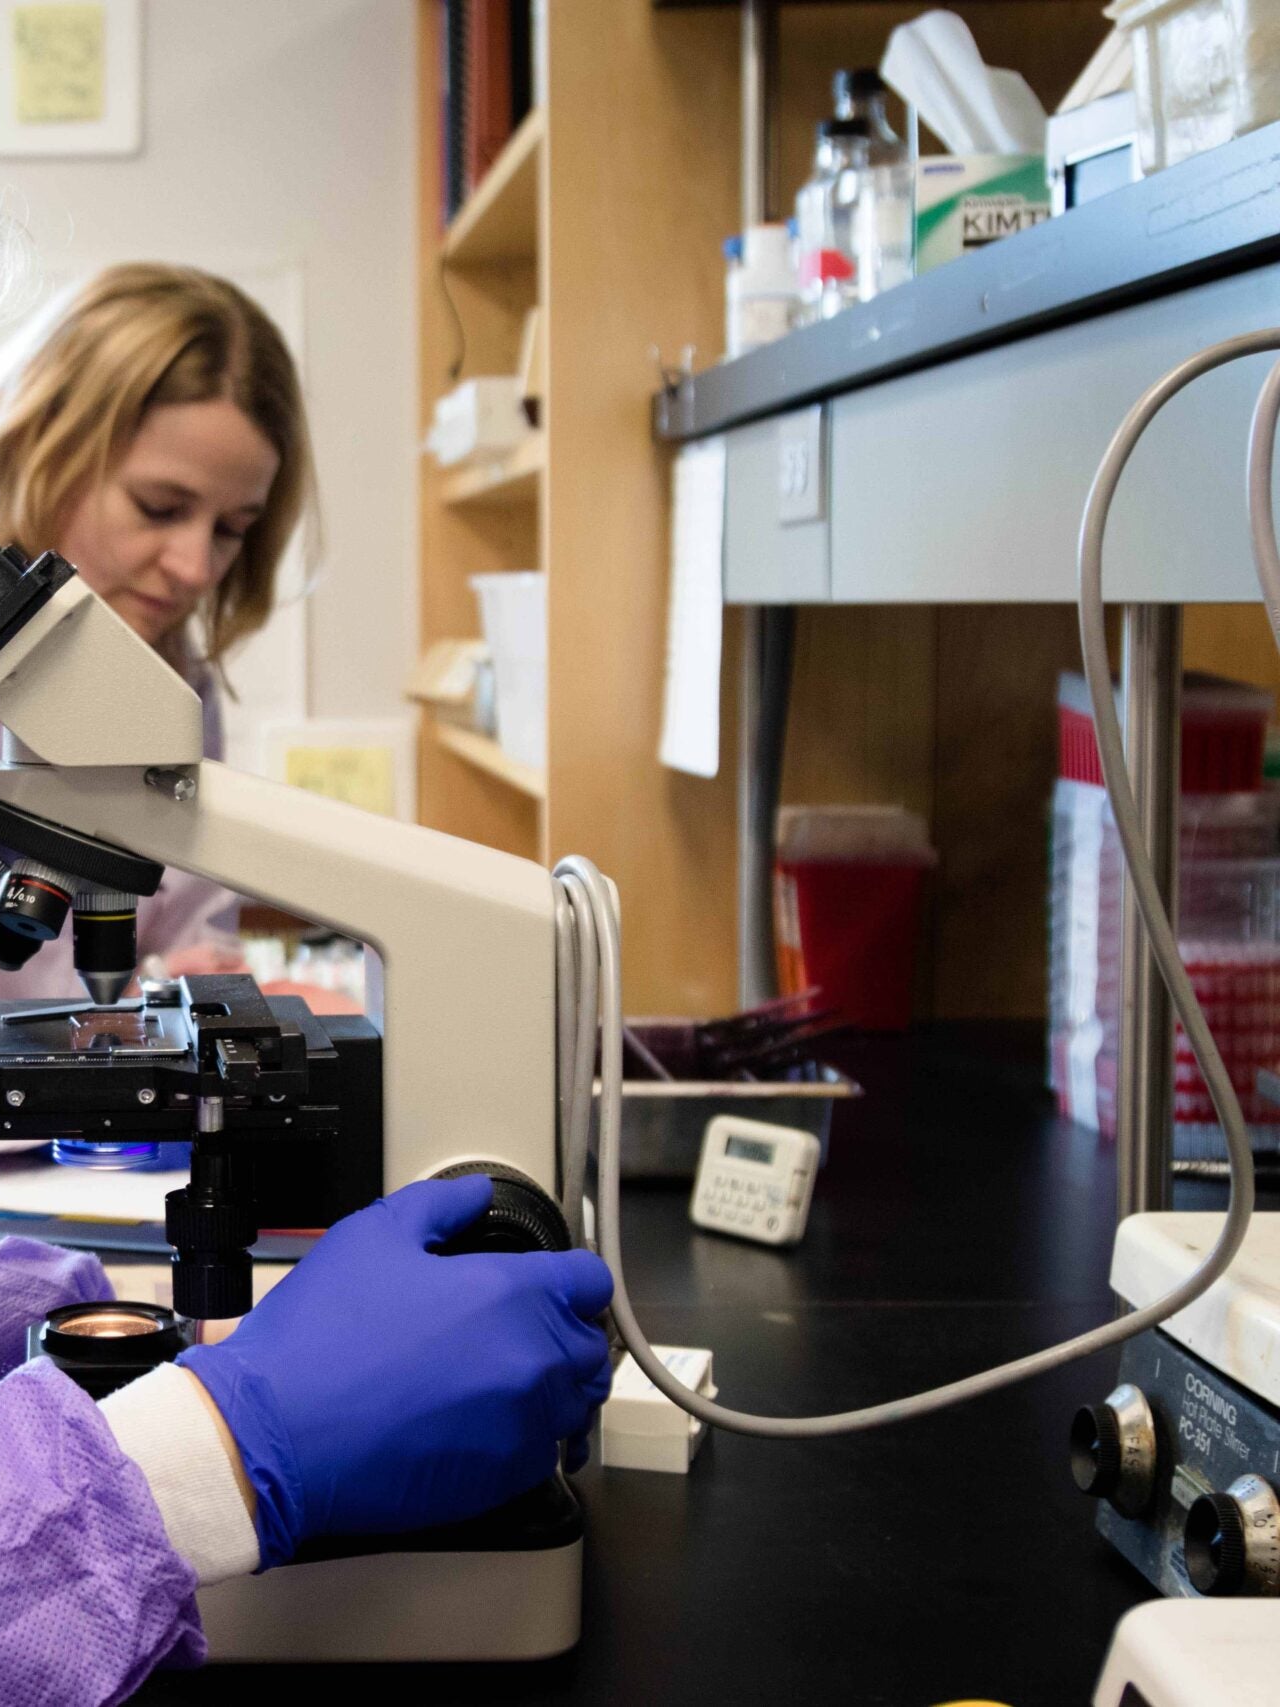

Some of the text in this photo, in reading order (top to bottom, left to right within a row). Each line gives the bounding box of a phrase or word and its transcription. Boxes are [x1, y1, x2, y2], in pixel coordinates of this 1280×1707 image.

[1182, 1393, 1198, 1419] Hot
[1198, 1406, 1222, 1438] Plate
[1185, 1373, 1237, 1426] CORNING
[1179, 1416, 1211, 1456] PC-351
